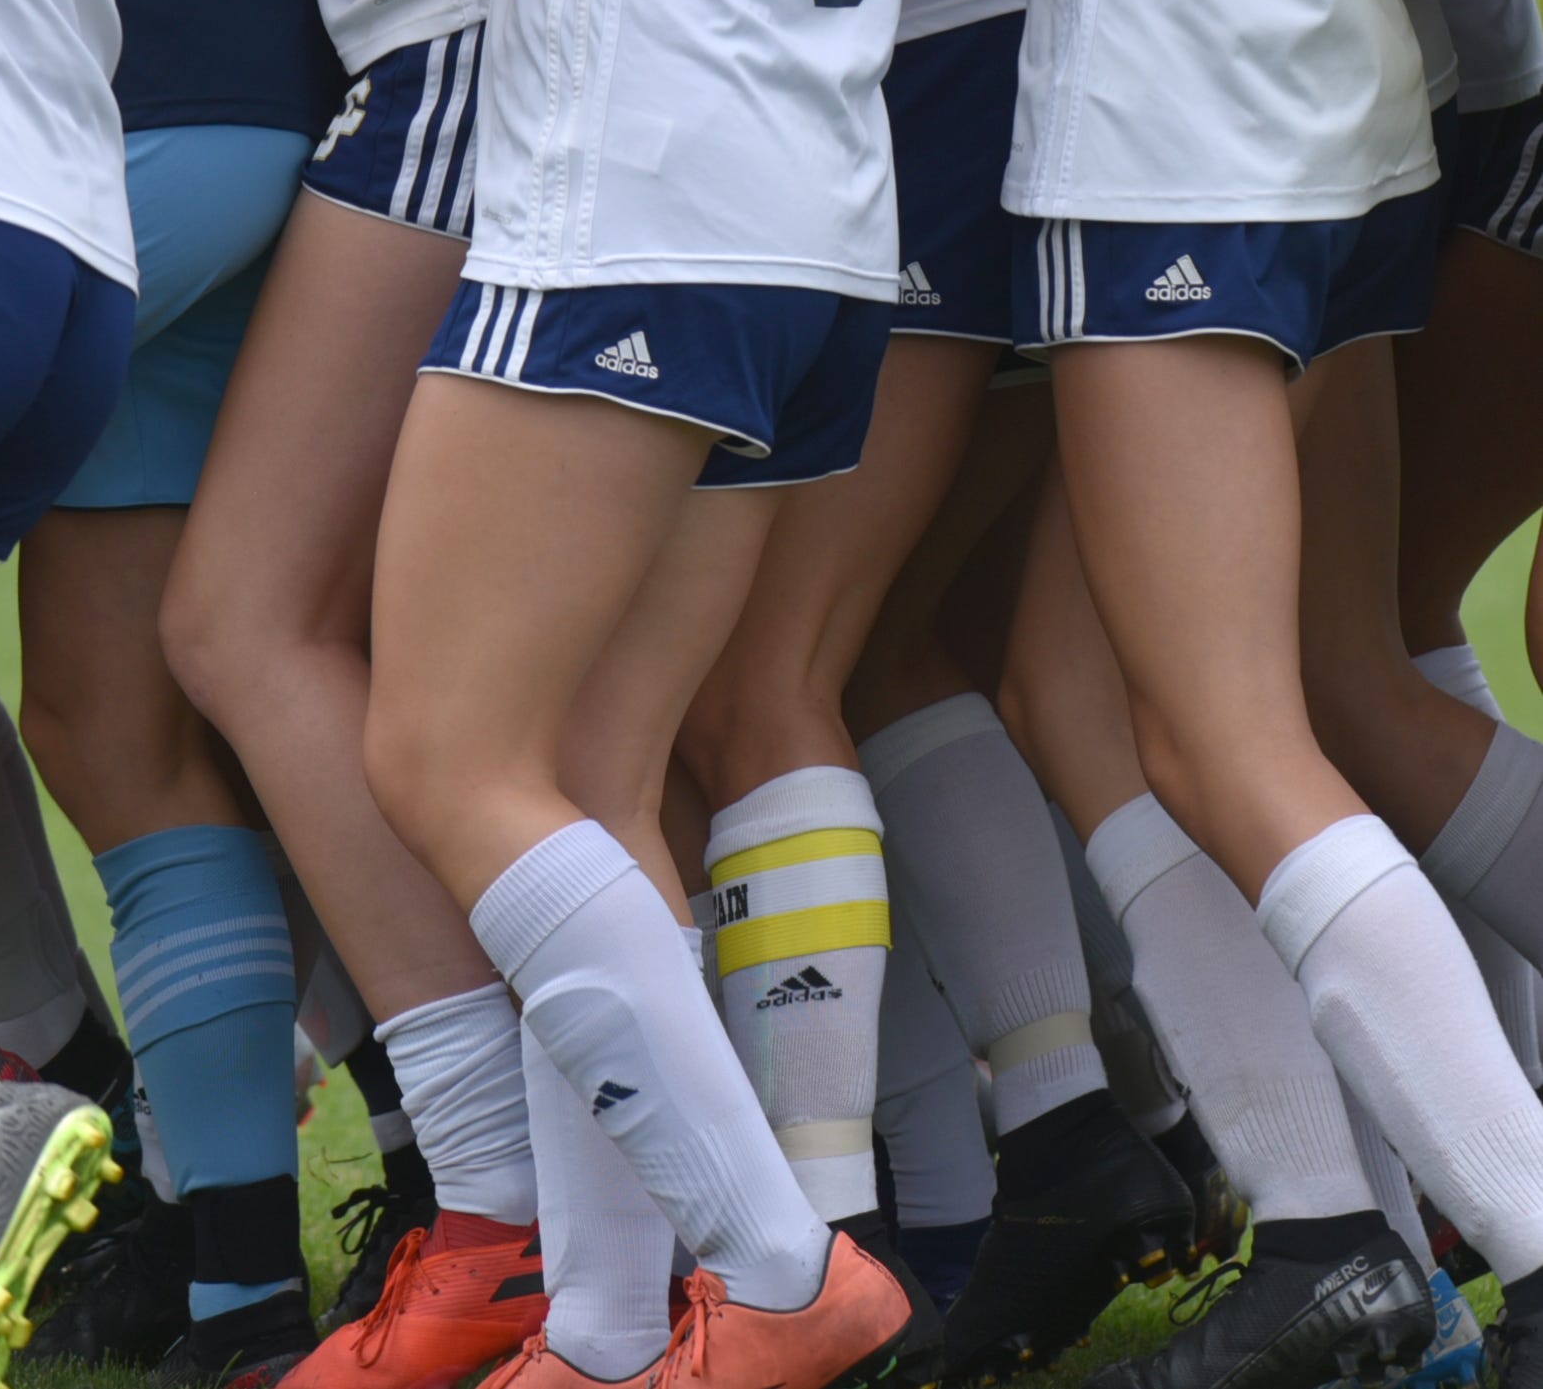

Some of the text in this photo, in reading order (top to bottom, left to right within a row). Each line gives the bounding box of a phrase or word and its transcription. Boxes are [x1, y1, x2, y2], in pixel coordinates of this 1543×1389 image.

[899, 286, 941, 305] idas
[1145, 284, 1212, 301] adidas
[595, 353, 659, 379] adidas
[756, 987, 843, 1009] adidas
[1314, 1255, 1370, 1302] MERC
[1363, 1265, 1392, 1291] NIKE
